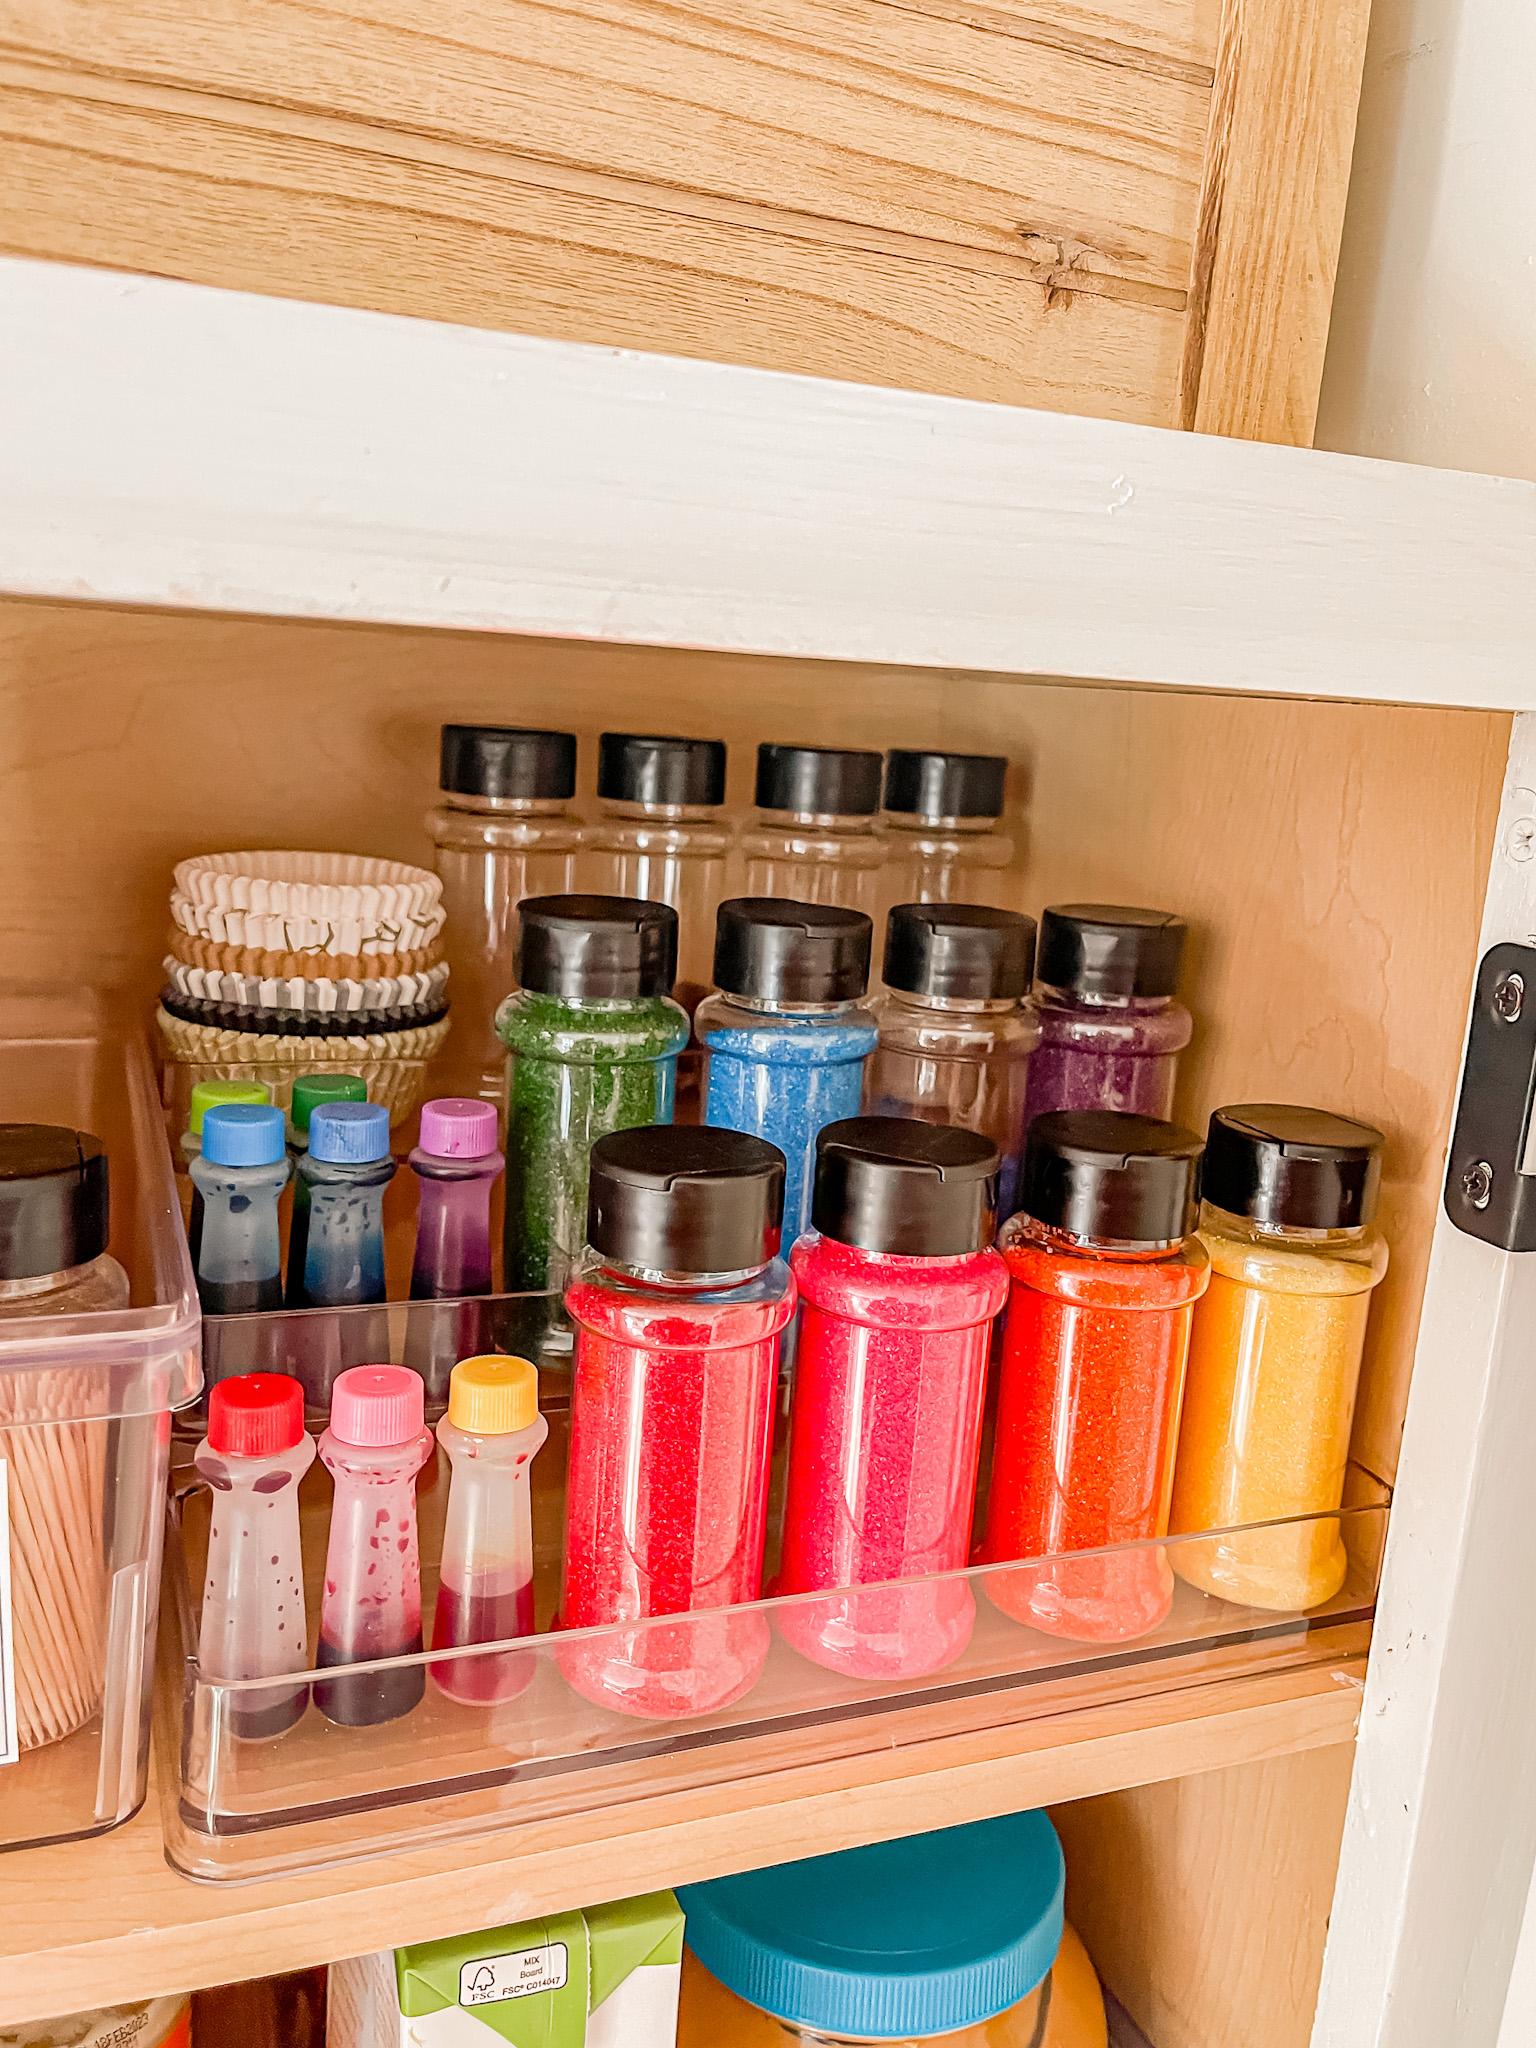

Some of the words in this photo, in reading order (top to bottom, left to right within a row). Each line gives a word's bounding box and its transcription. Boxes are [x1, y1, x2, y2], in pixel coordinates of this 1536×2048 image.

[524, 1955, 540, 1967] MIX
[520, 1966, 543, 1979] Board
[471, 1990, 495, 2002] FSC
